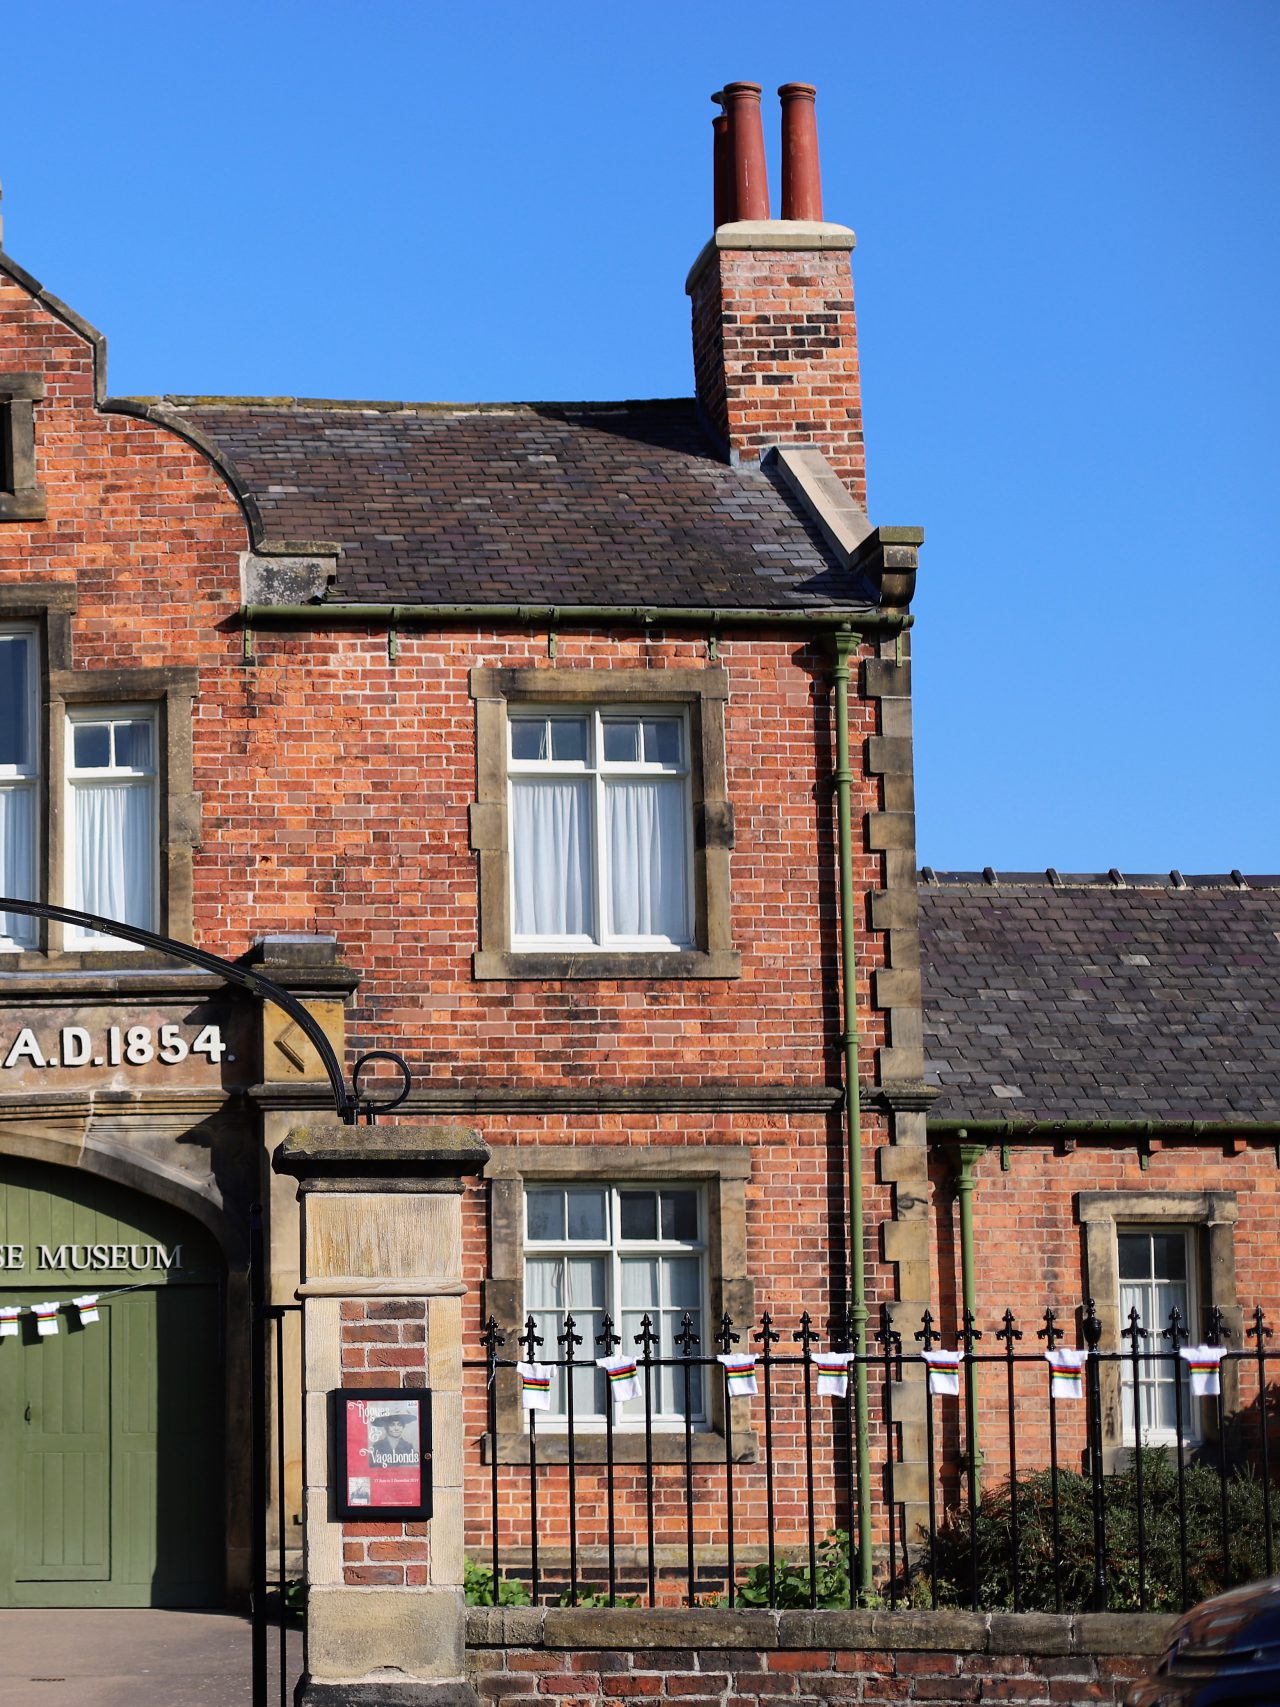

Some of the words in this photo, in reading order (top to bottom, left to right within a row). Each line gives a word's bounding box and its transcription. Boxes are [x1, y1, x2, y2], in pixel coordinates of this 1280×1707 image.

[38, 1244, 184, 1271] MUSEUM
[348, 1400, 390, 1424] Rogues
[369, 1426, 383, 1442] &
[359, 1447, 419, 1468] Vagabonds
